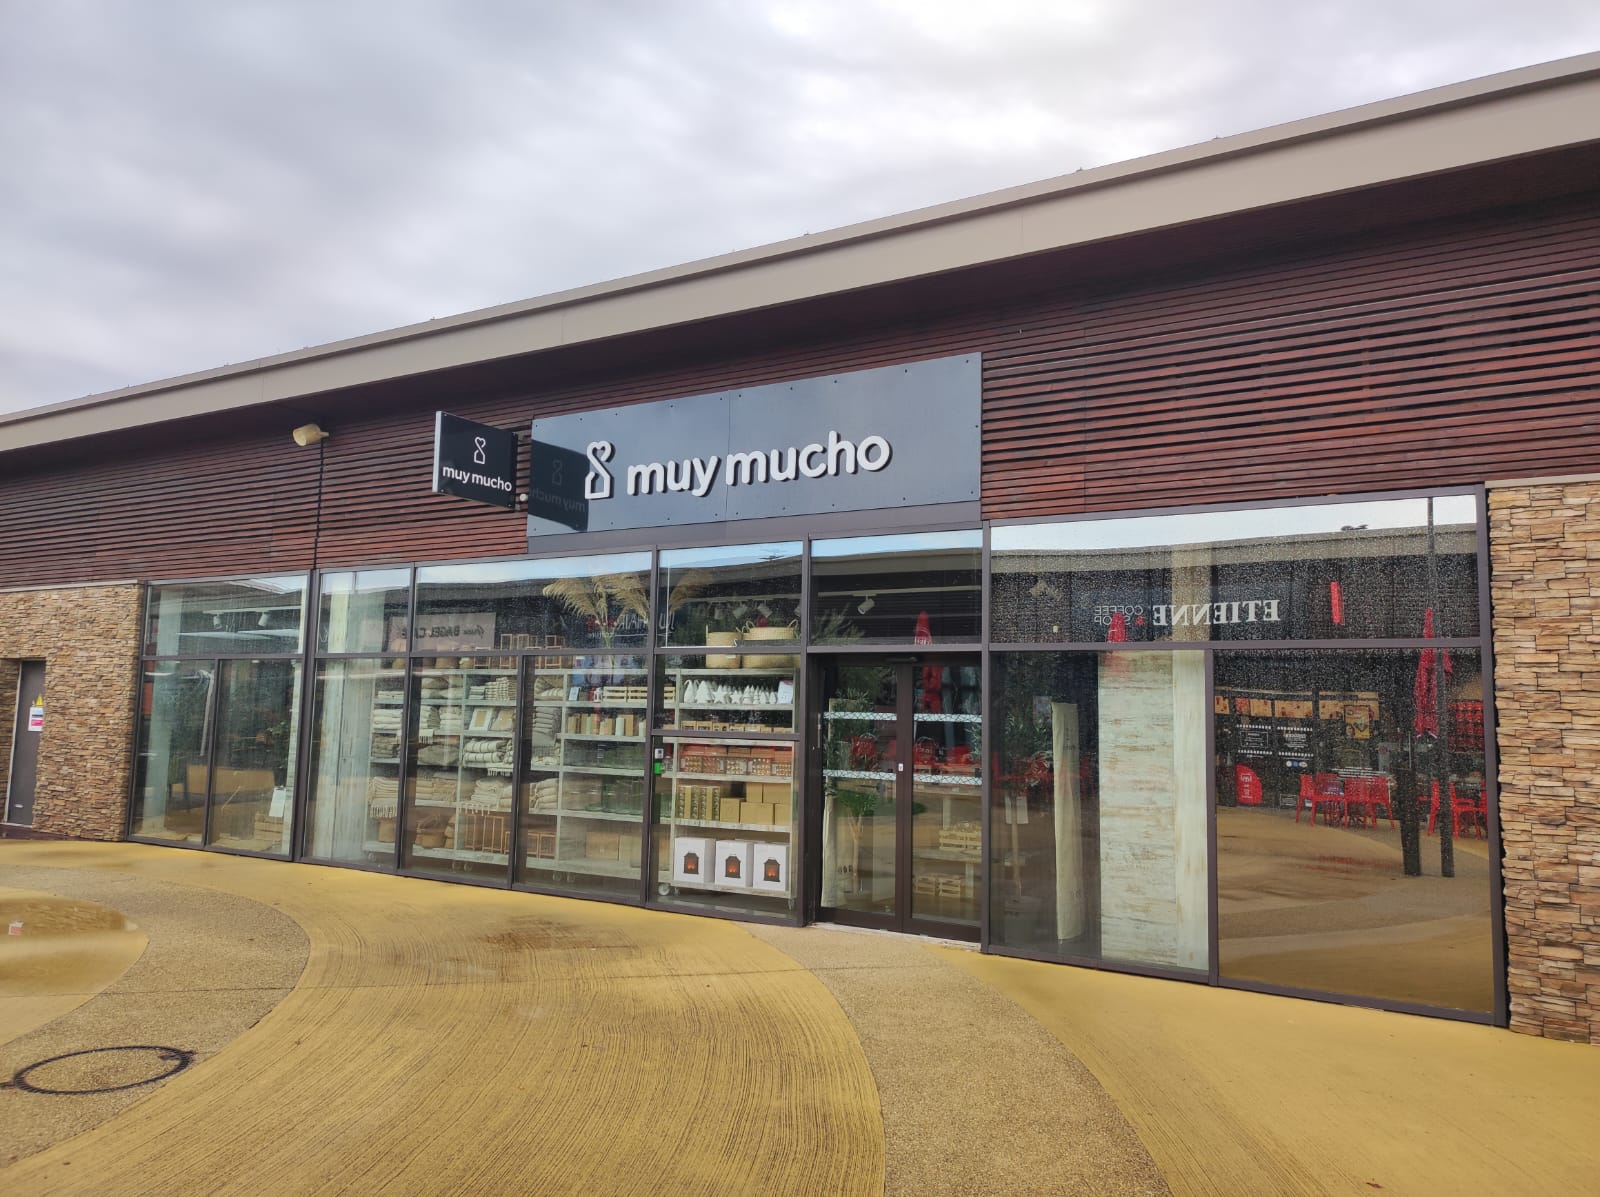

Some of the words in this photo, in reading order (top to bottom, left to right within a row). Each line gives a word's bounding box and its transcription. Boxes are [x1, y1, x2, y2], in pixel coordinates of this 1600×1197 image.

[442, 466, 470, 484] muy
[471, 473, 513, 492] mucho
[627, 455, 720, 497] muy
[725, 430, 891, 485] mucho
